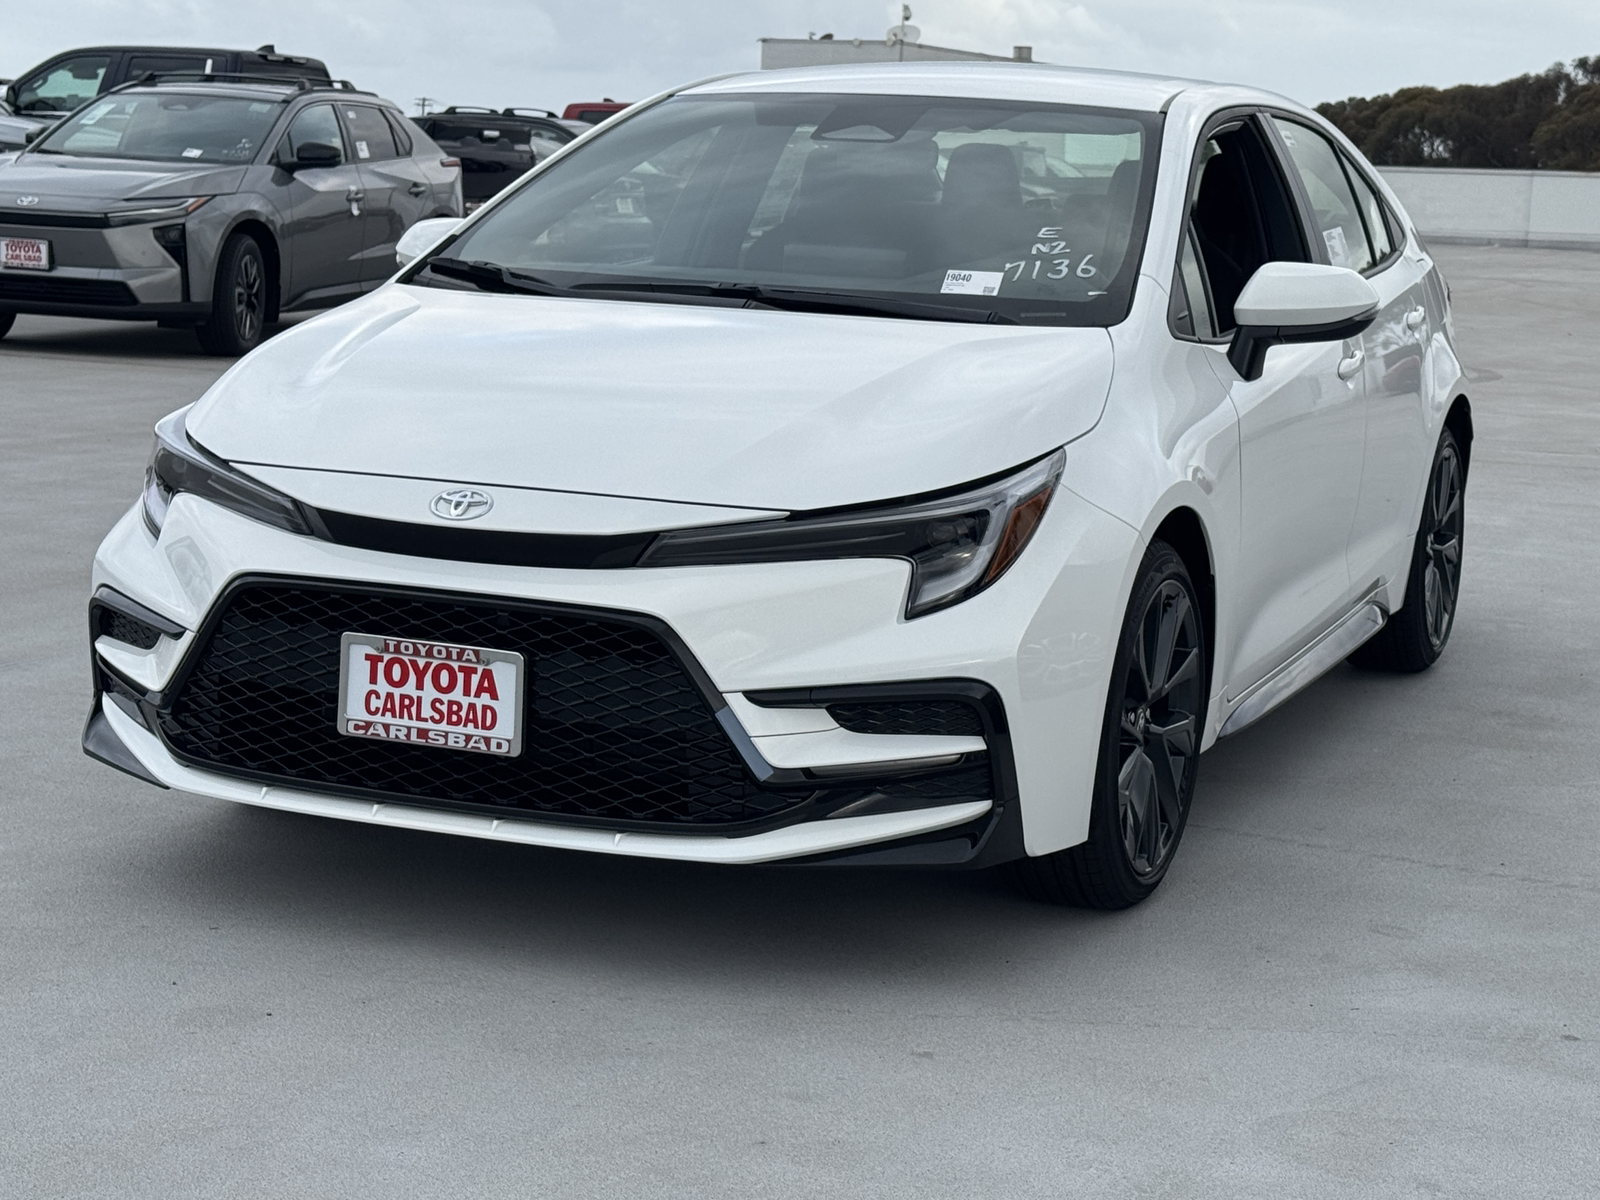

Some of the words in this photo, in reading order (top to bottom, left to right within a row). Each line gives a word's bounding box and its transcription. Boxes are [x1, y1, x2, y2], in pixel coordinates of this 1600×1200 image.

[1037, 227, 1063, 238] E
[5, 243, 42, 254] TOYOTA
[1003, 254, 1097, 282] 7136
[385, 639, 478, 662] TOYOTA
[364, 653, 500, 701] TOYOTA
[364, 689, 498, 731] CARLSBAD
[347, 720, 510, 754] CARLSBAD
